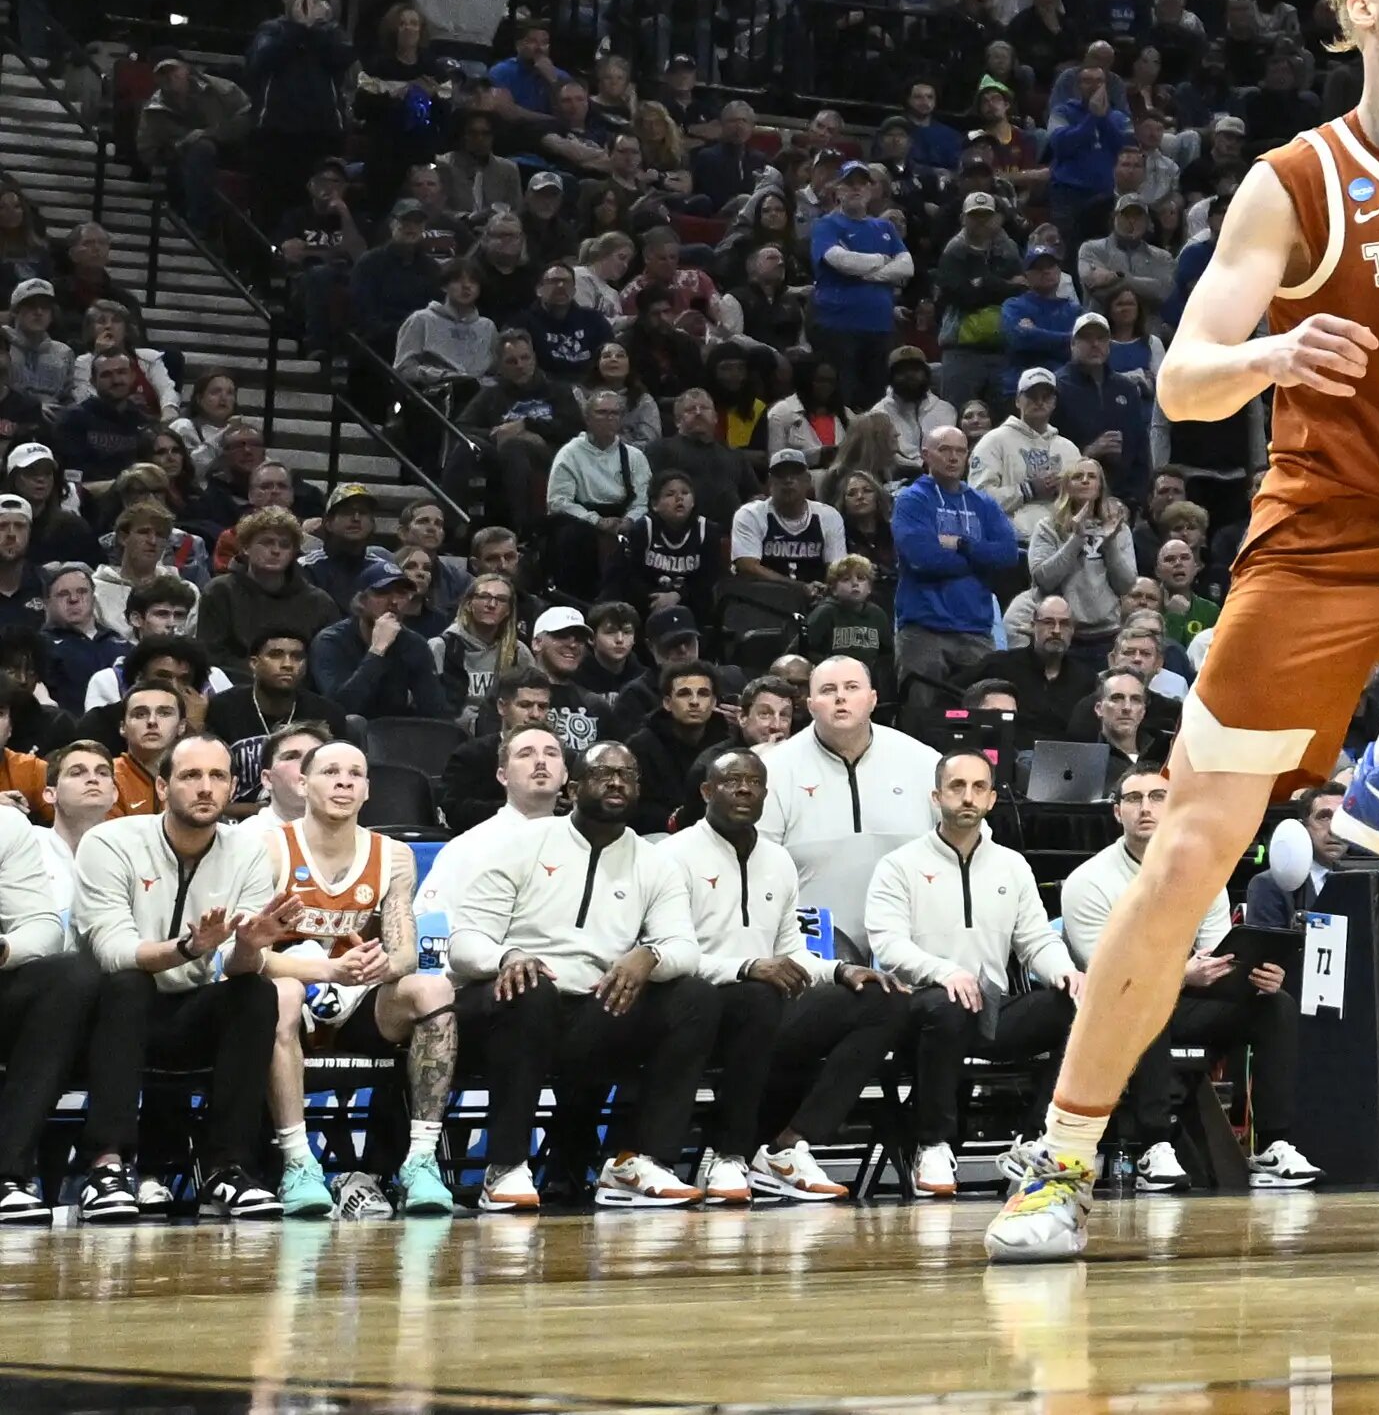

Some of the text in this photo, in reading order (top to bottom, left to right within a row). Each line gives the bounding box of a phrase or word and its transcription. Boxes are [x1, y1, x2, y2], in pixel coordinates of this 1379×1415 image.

[296, 907, 374, 937] EXAS
[1316, 946, 1333, 976] T1
[351, 1057, 373, 1069] FINAL
[374, 1057, 395, 1069] FOUR
[341, 1189, 366, 1216] FOU
